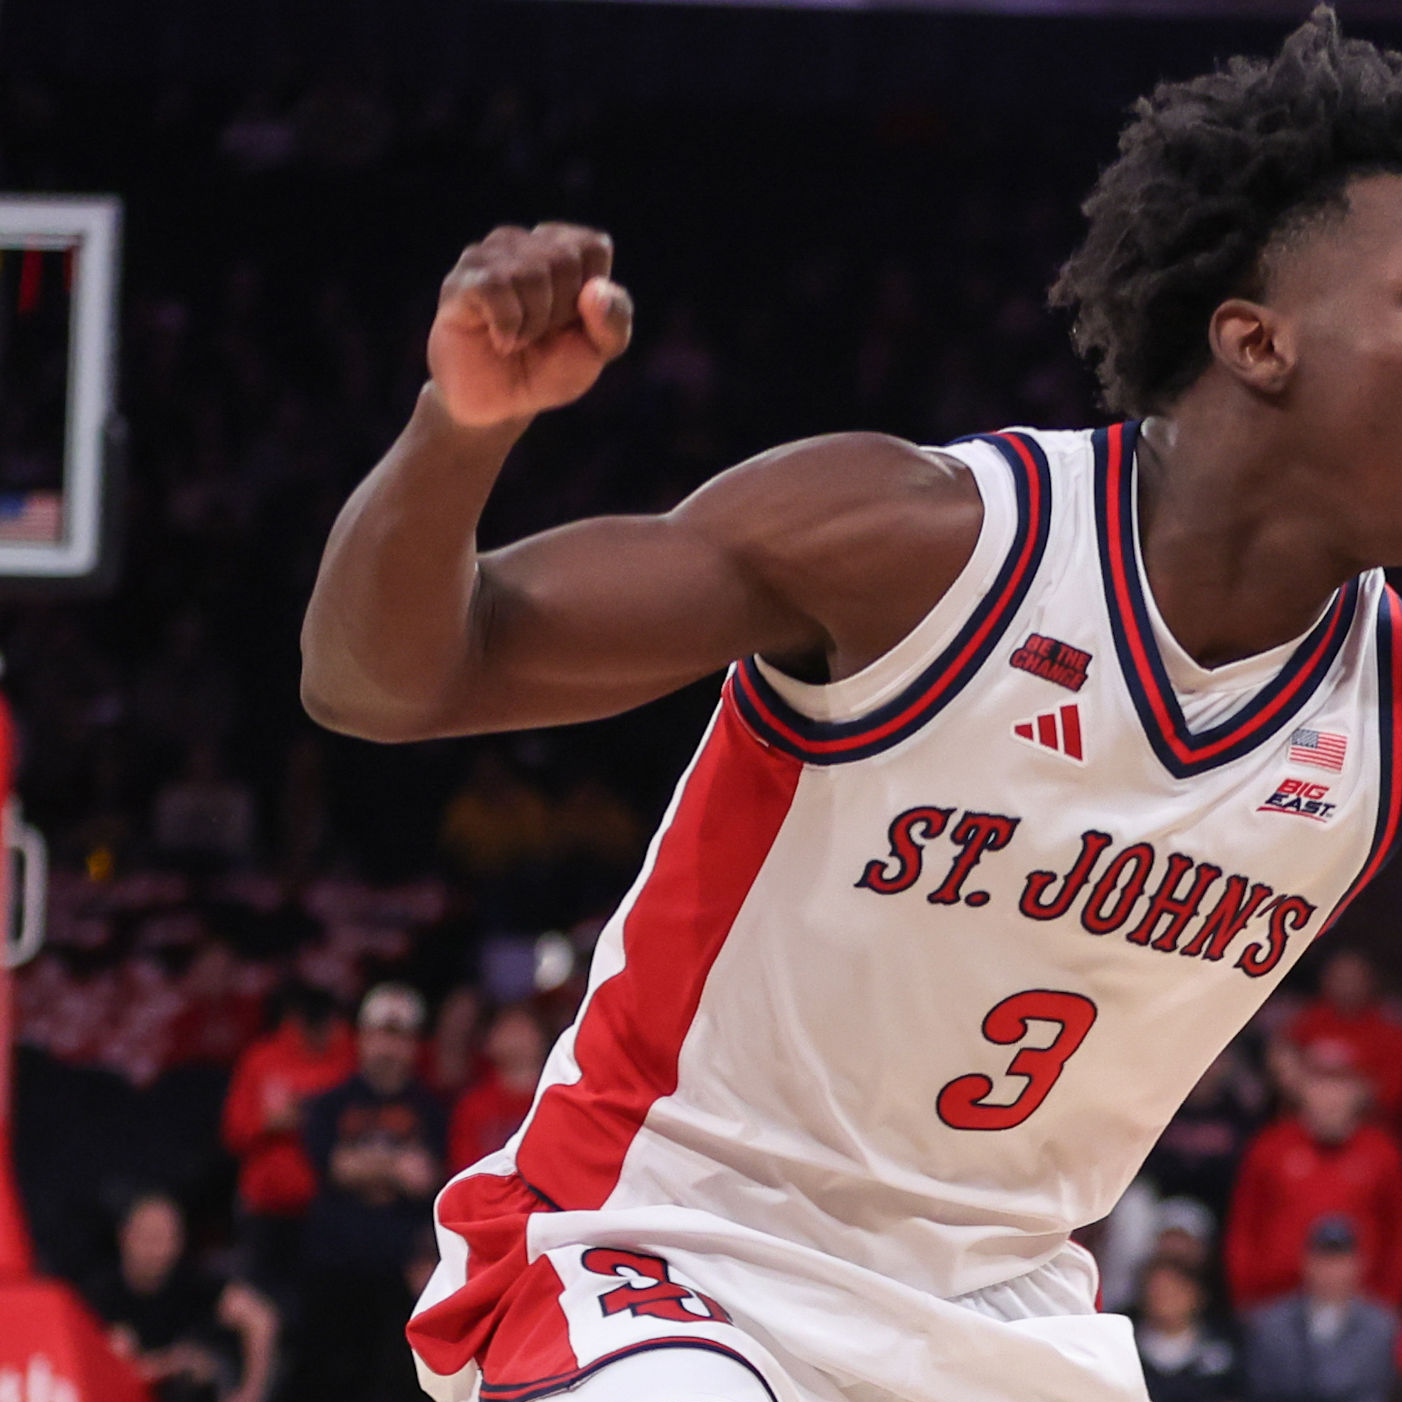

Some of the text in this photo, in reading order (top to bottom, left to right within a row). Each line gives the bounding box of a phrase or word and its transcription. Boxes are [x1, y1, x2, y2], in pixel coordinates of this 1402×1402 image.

[1264, 791, 1336, 817] EAST
[1276, 778, 1330, 800] BIG
[855, 805, 1318, 979] ST. JOHN'S
[936, 988, 1098, 1132] 3
